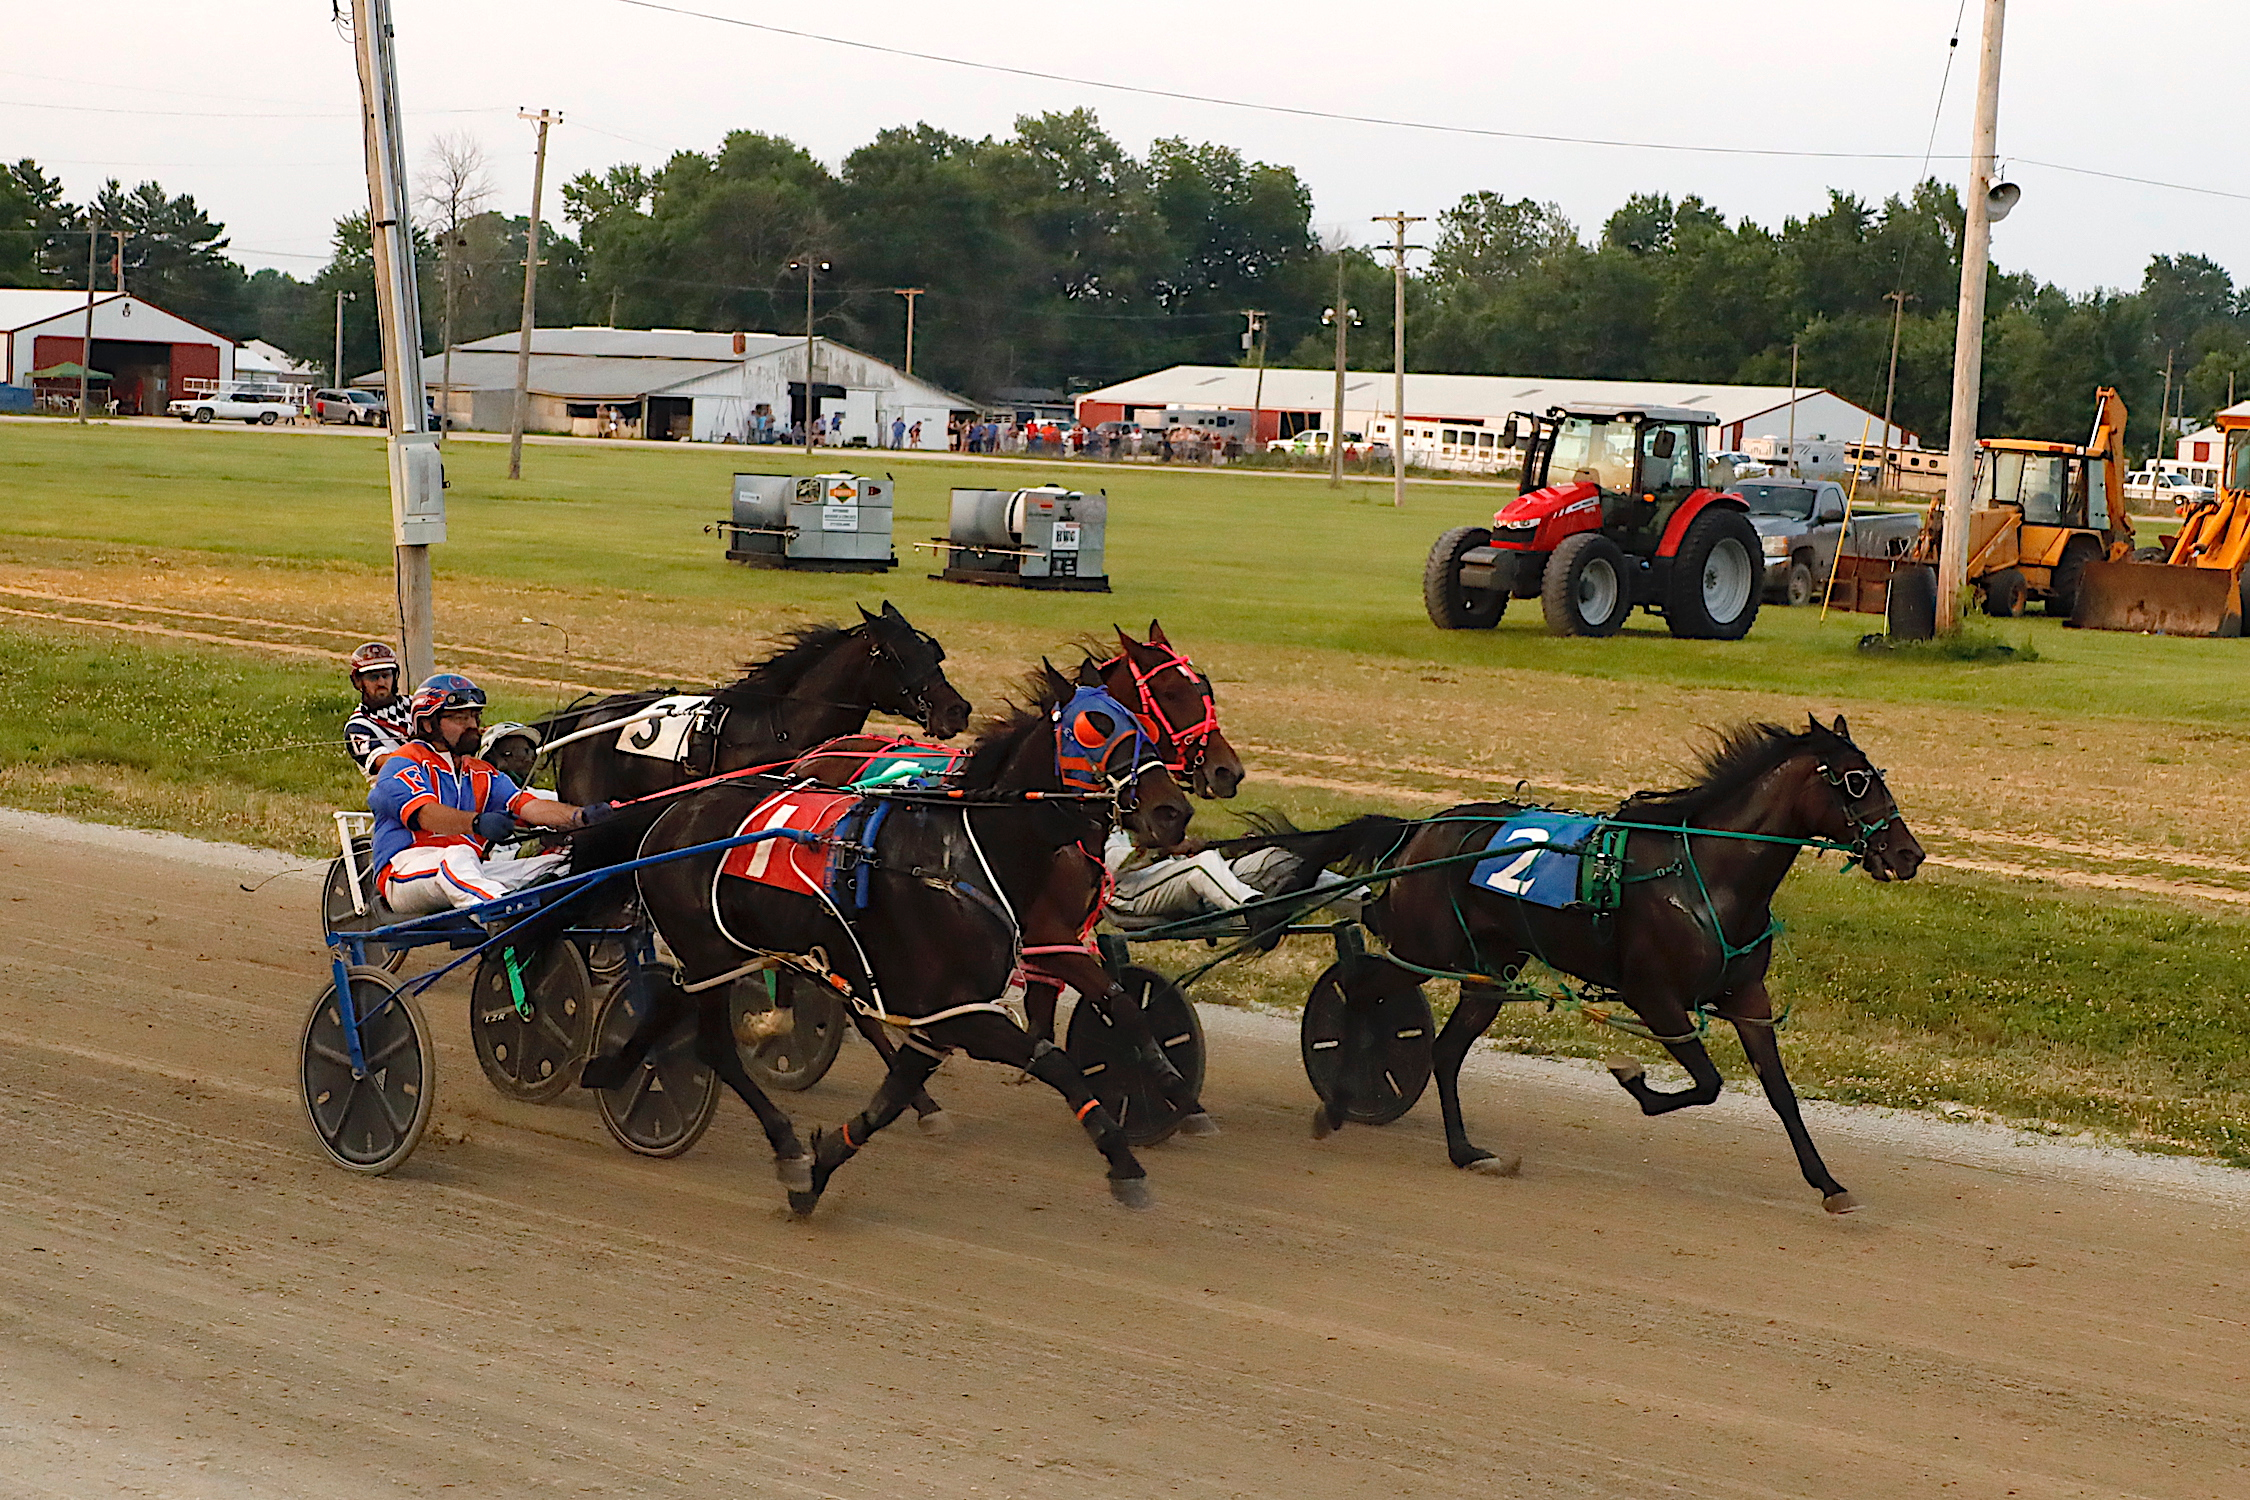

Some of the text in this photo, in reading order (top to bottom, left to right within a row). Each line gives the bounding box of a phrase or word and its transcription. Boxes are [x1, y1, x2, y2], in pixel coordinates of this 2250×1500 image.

[393, 765, 426, 795] F
[745, 804, 800, 878] 1
[1486, 827, 1550, 896] 2
